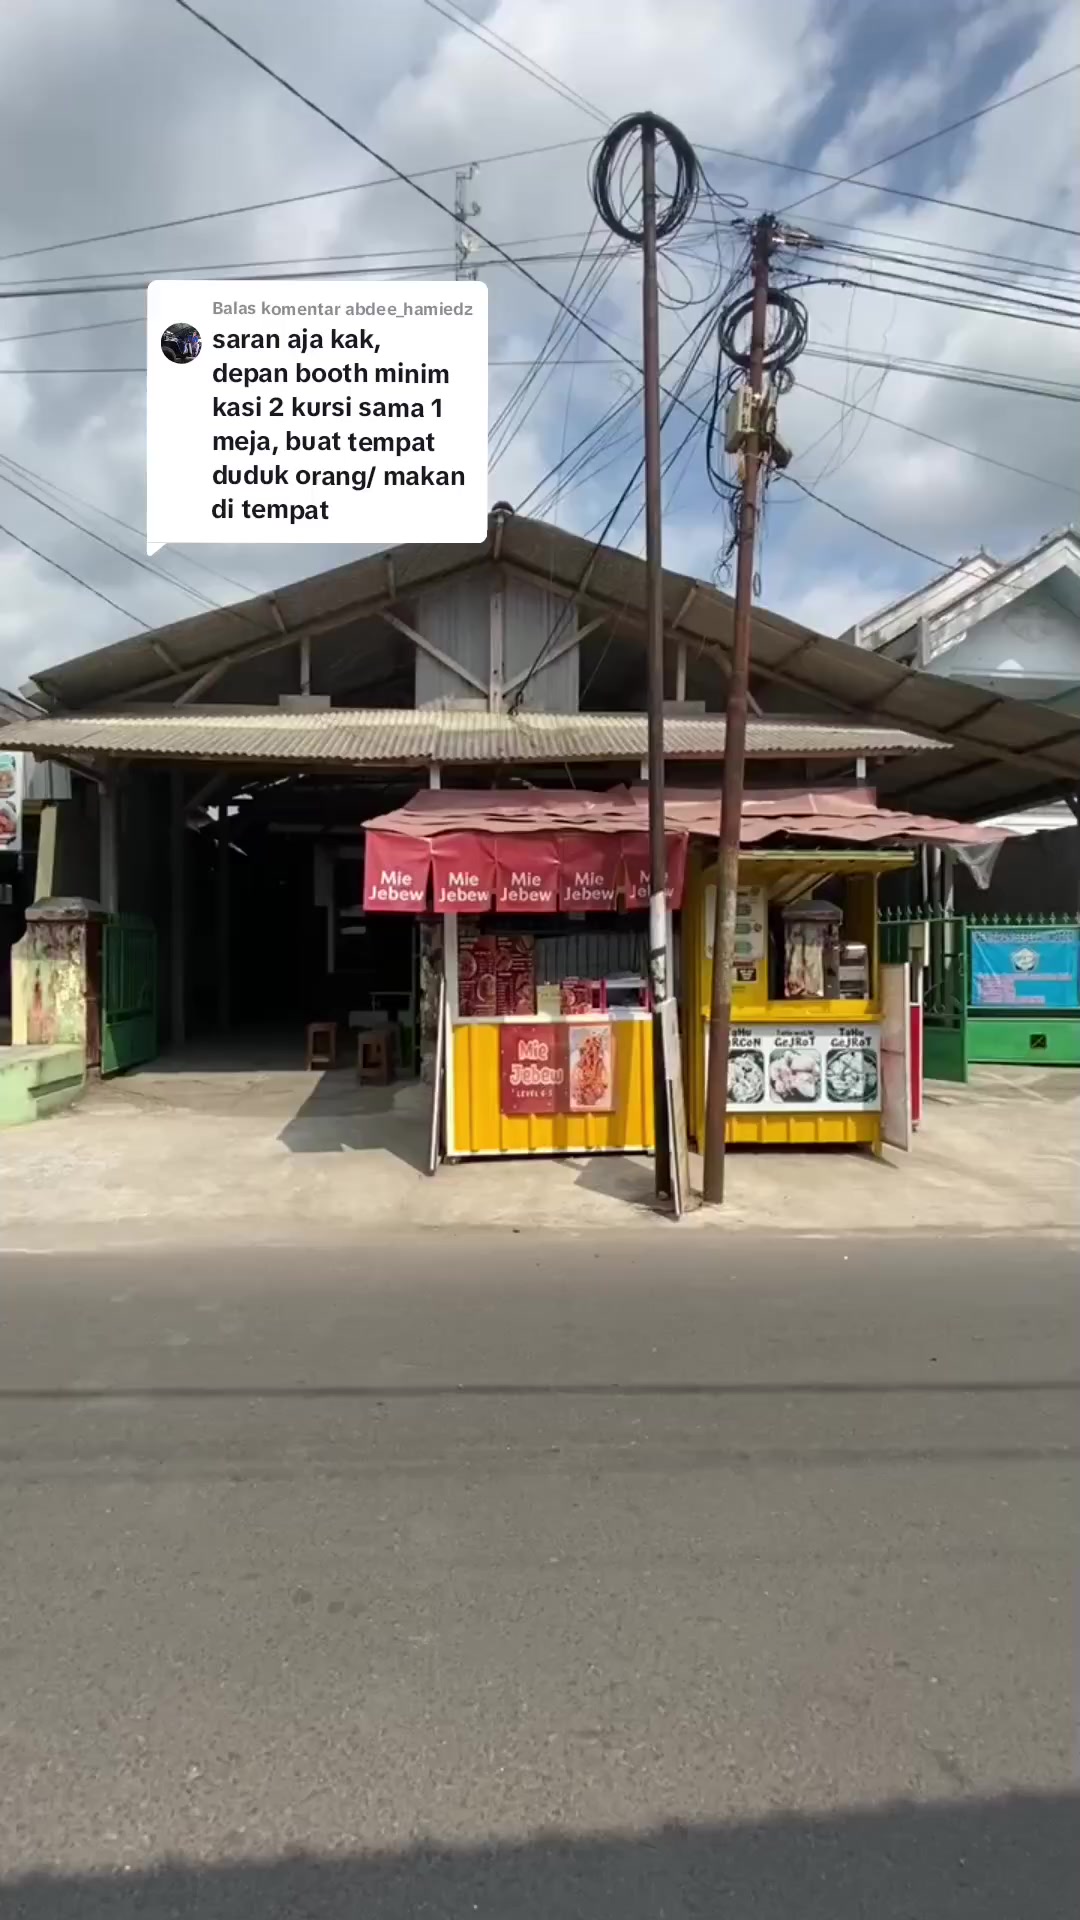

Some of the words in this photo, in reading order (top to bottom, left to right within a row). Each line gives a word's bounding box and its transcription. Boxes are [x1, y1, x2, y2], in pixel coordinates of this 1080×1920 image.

[381, 870, 412, 886] Mie
[449, 872, 479, 886] Mie
[511, 872, 541, 886] Mie
[575, 872, 604, 886] Mie
[368, 885, 424, 901] Jebew
[439, 887, 489, 902] Jebew
[500, 887, 552, 902] Jebew
[564, 886, 614, 901] Jebew
[519, 1039, 549, 1061] Mie
[510, 1064, 564, 1086] Jebew
